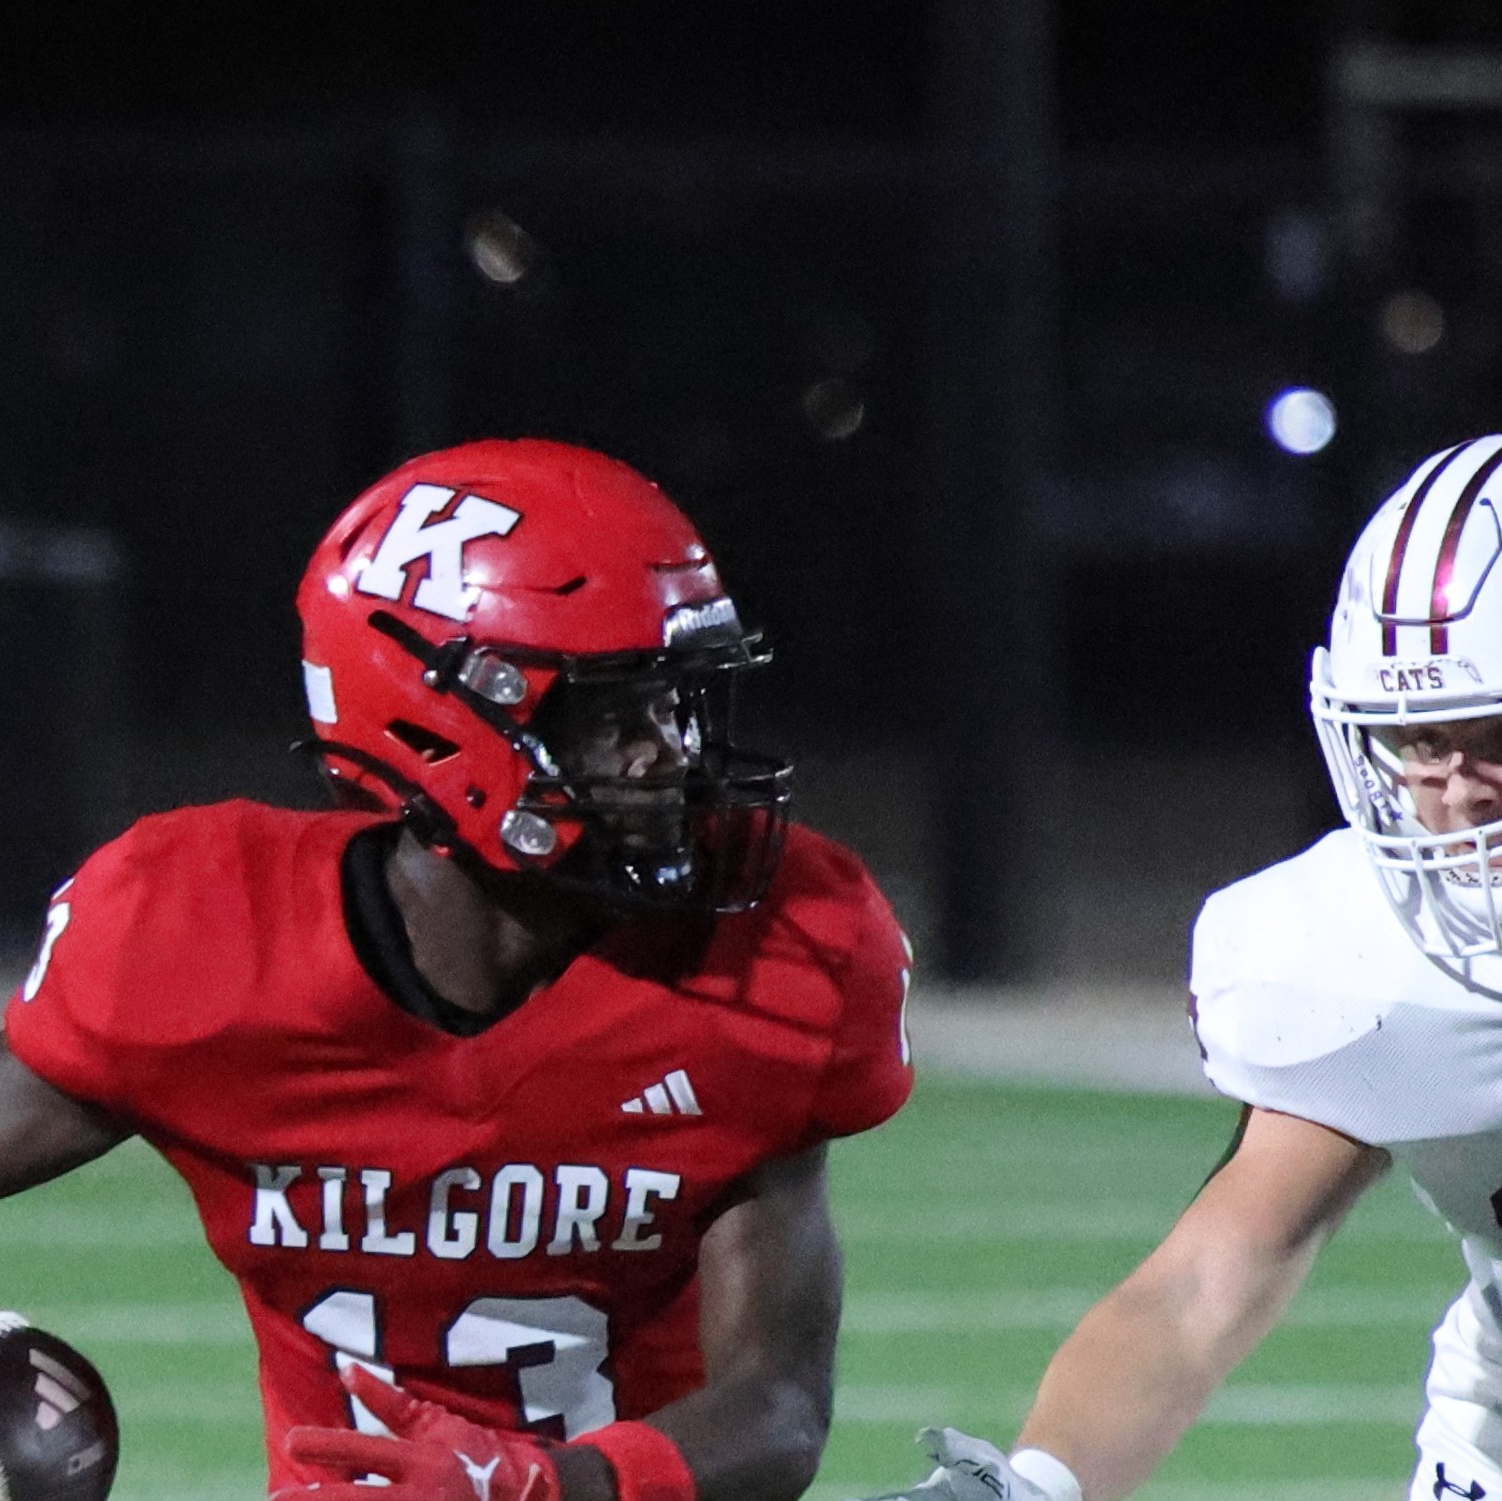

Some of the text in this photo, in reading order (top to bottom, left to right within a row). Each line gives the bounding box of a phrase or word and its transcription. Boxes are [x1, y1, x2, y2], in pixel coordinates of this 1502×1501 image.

[356, 481, 524, 623] K
[1379, 666, 1444, 692] CATS
[247, 1162, 682, 1260] KILGORE
[302, 1291, 616, 1488] 13
